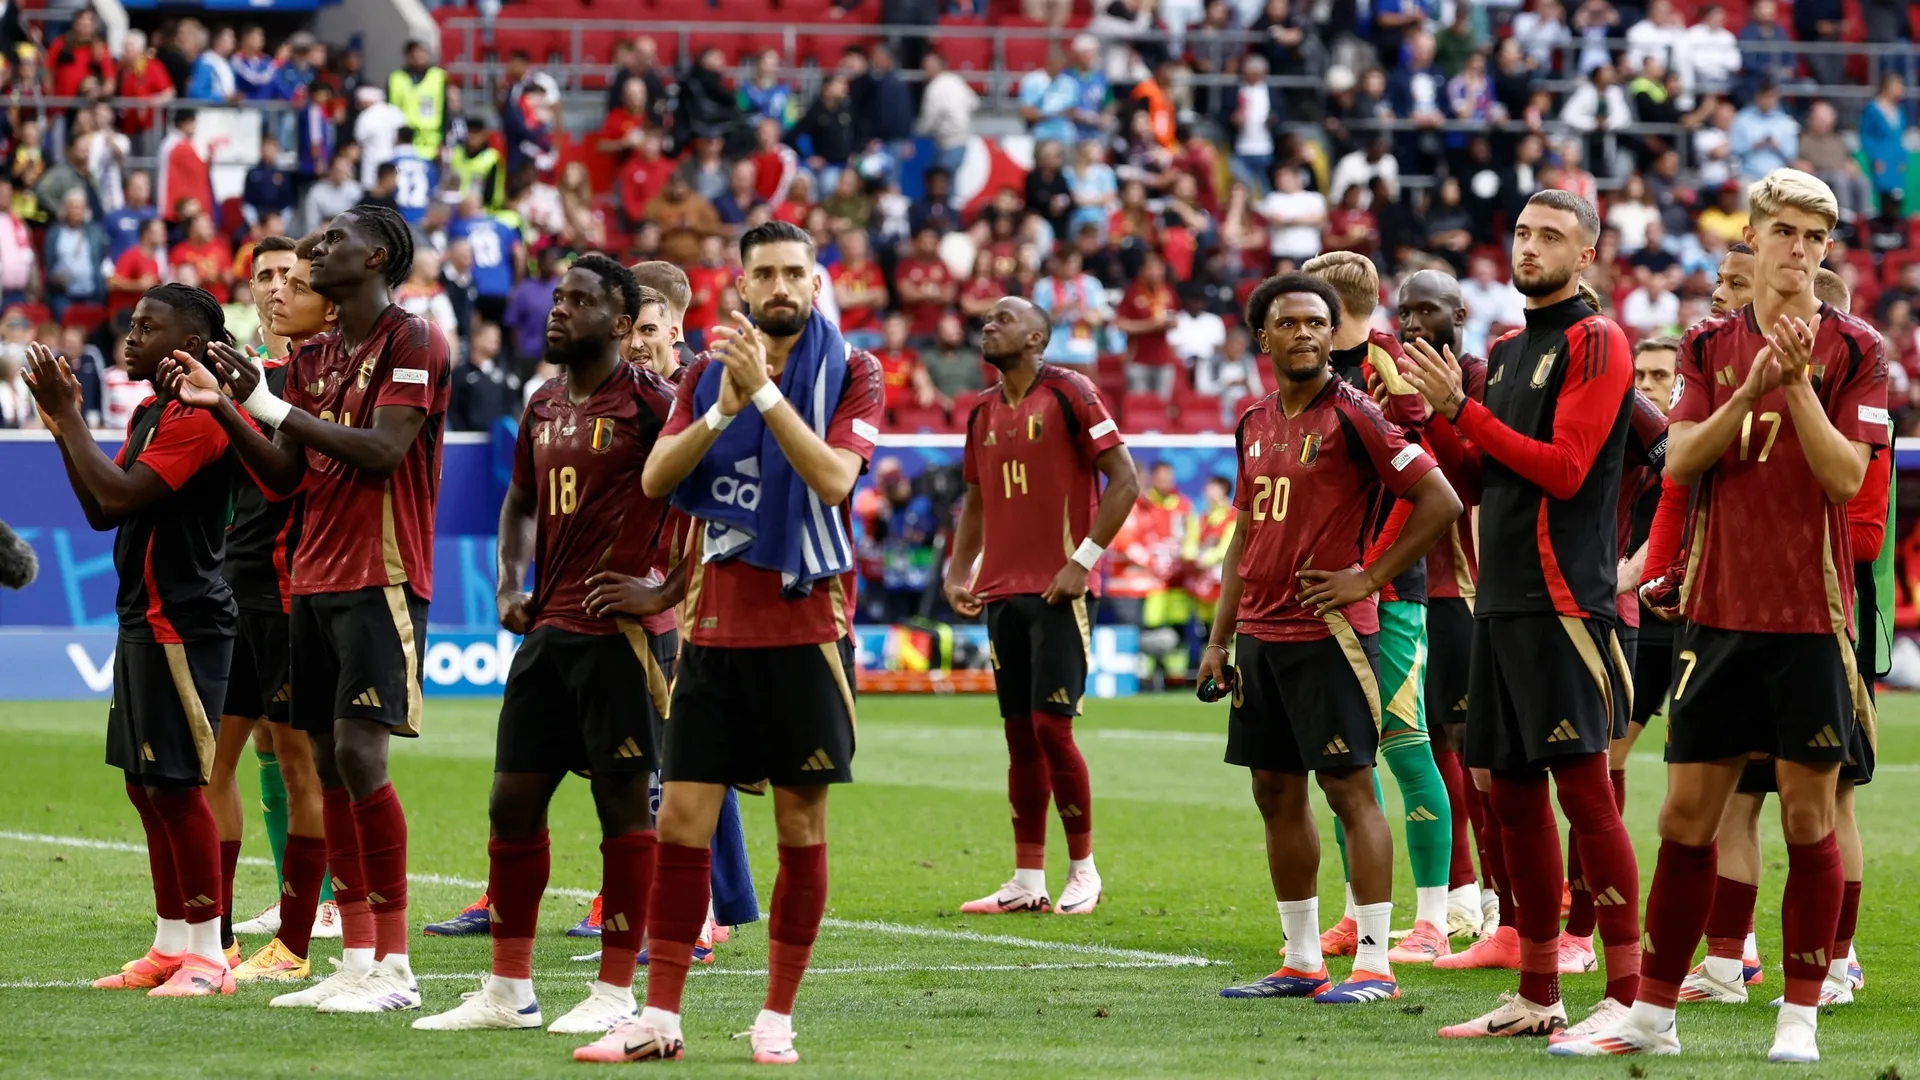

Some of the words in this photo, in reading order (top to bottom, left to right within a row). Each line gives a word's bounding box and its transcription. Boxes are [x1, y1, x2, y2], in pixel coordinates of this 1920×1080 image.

[1740, 411, 1781, 462] 17
[549, 466, 577, 516] 18
[1002, 459, 1028, 499] 14
[1252, 475, 1291, 522] 20
[1674, 650, 1697, 700] 7
